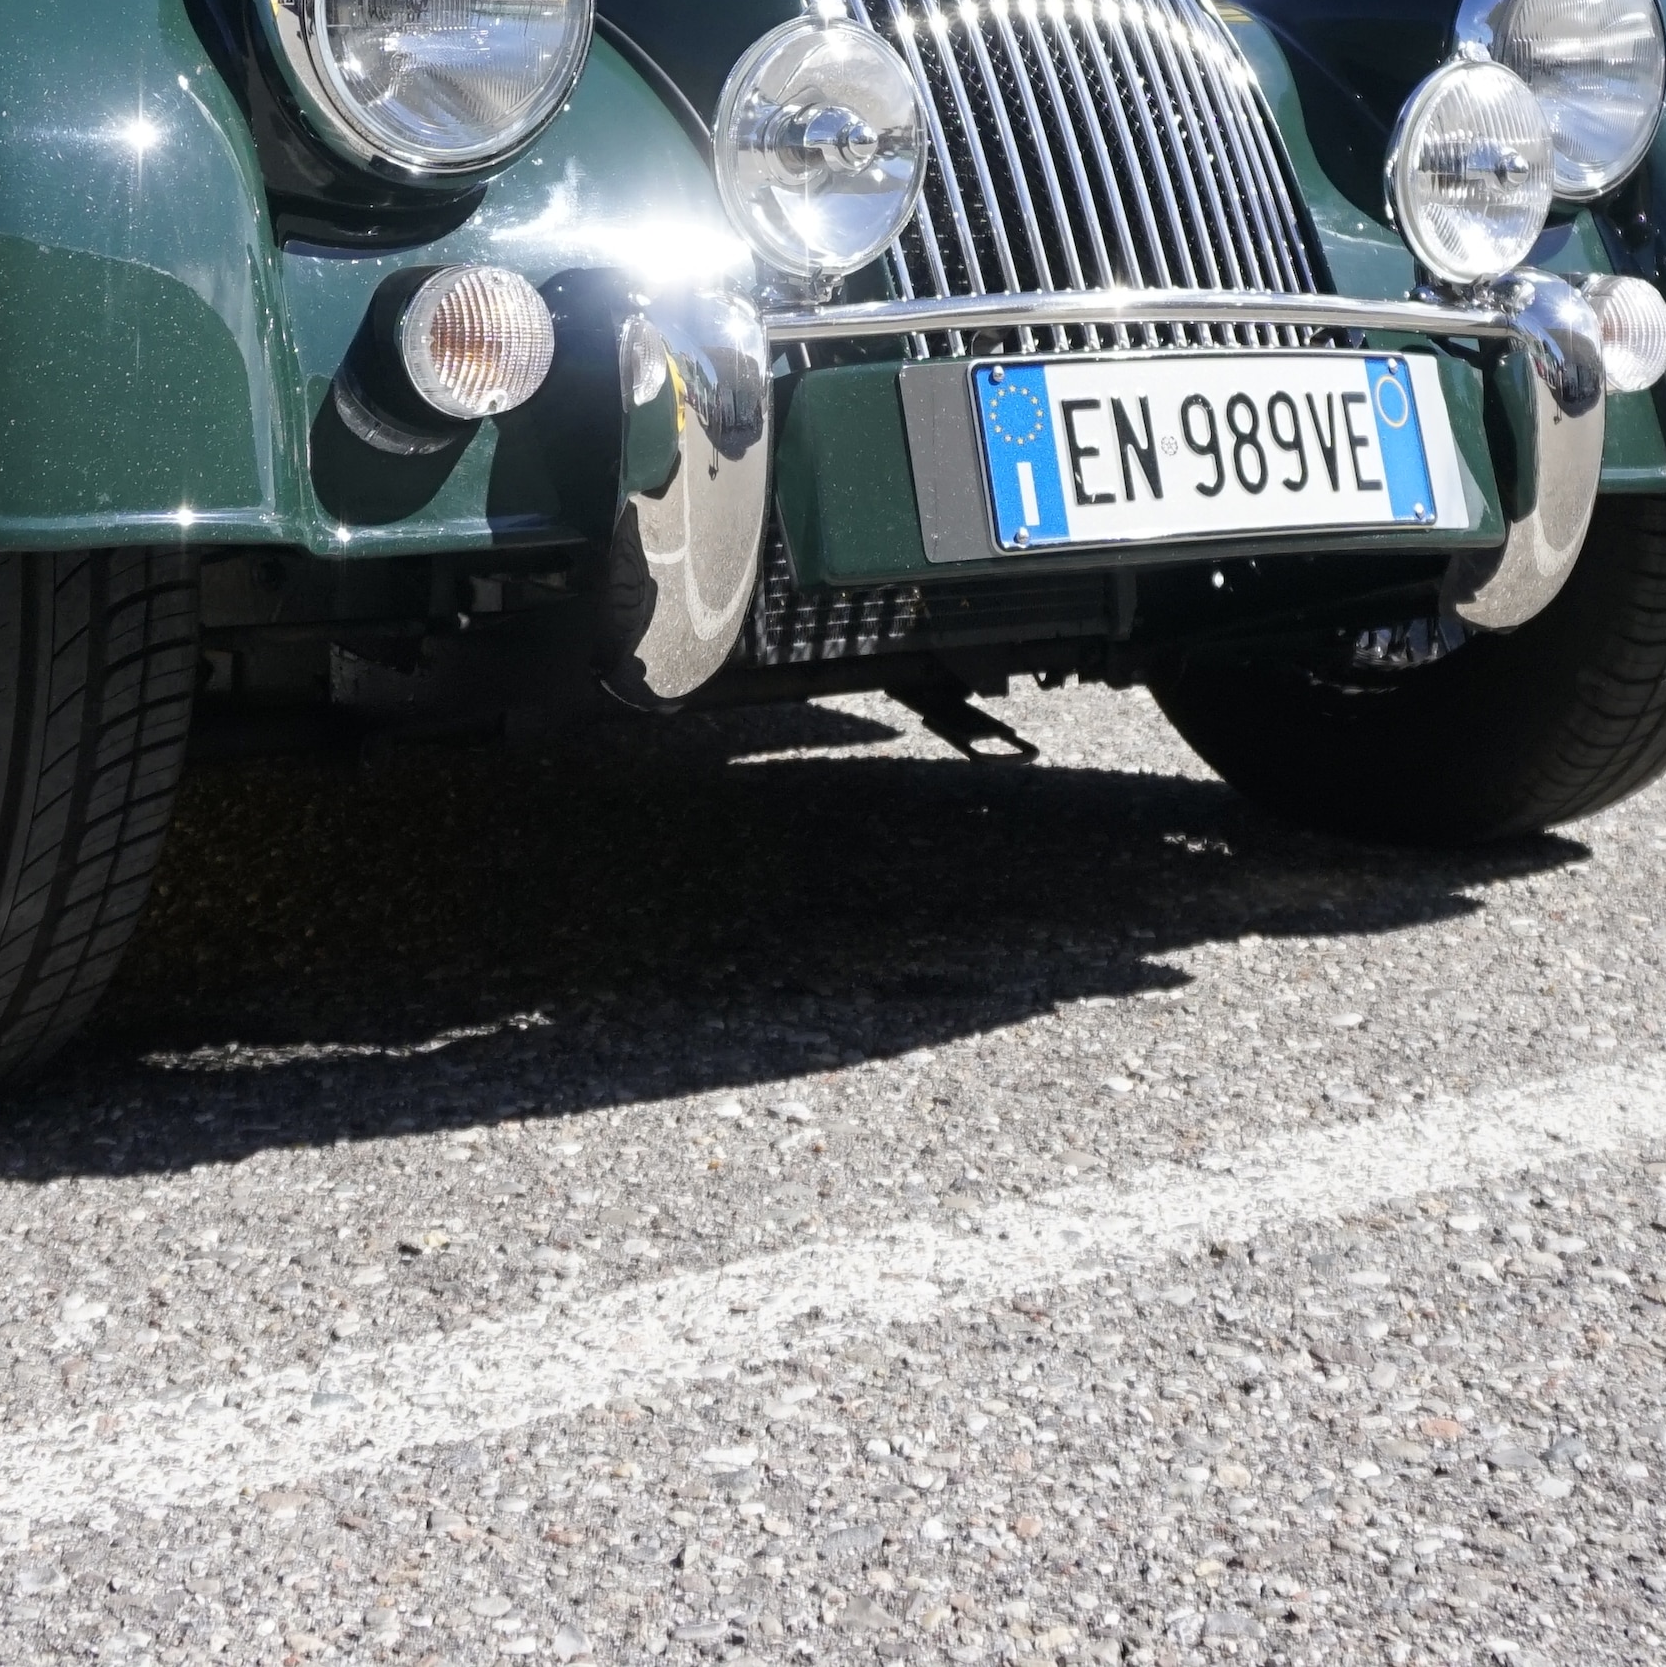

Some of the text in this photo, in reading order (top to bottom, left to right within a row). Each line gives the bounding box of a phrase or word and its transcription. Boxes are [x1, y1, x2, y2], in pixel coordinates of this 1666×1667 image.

[1017, 389, 1384, 527] I EN 989VE
